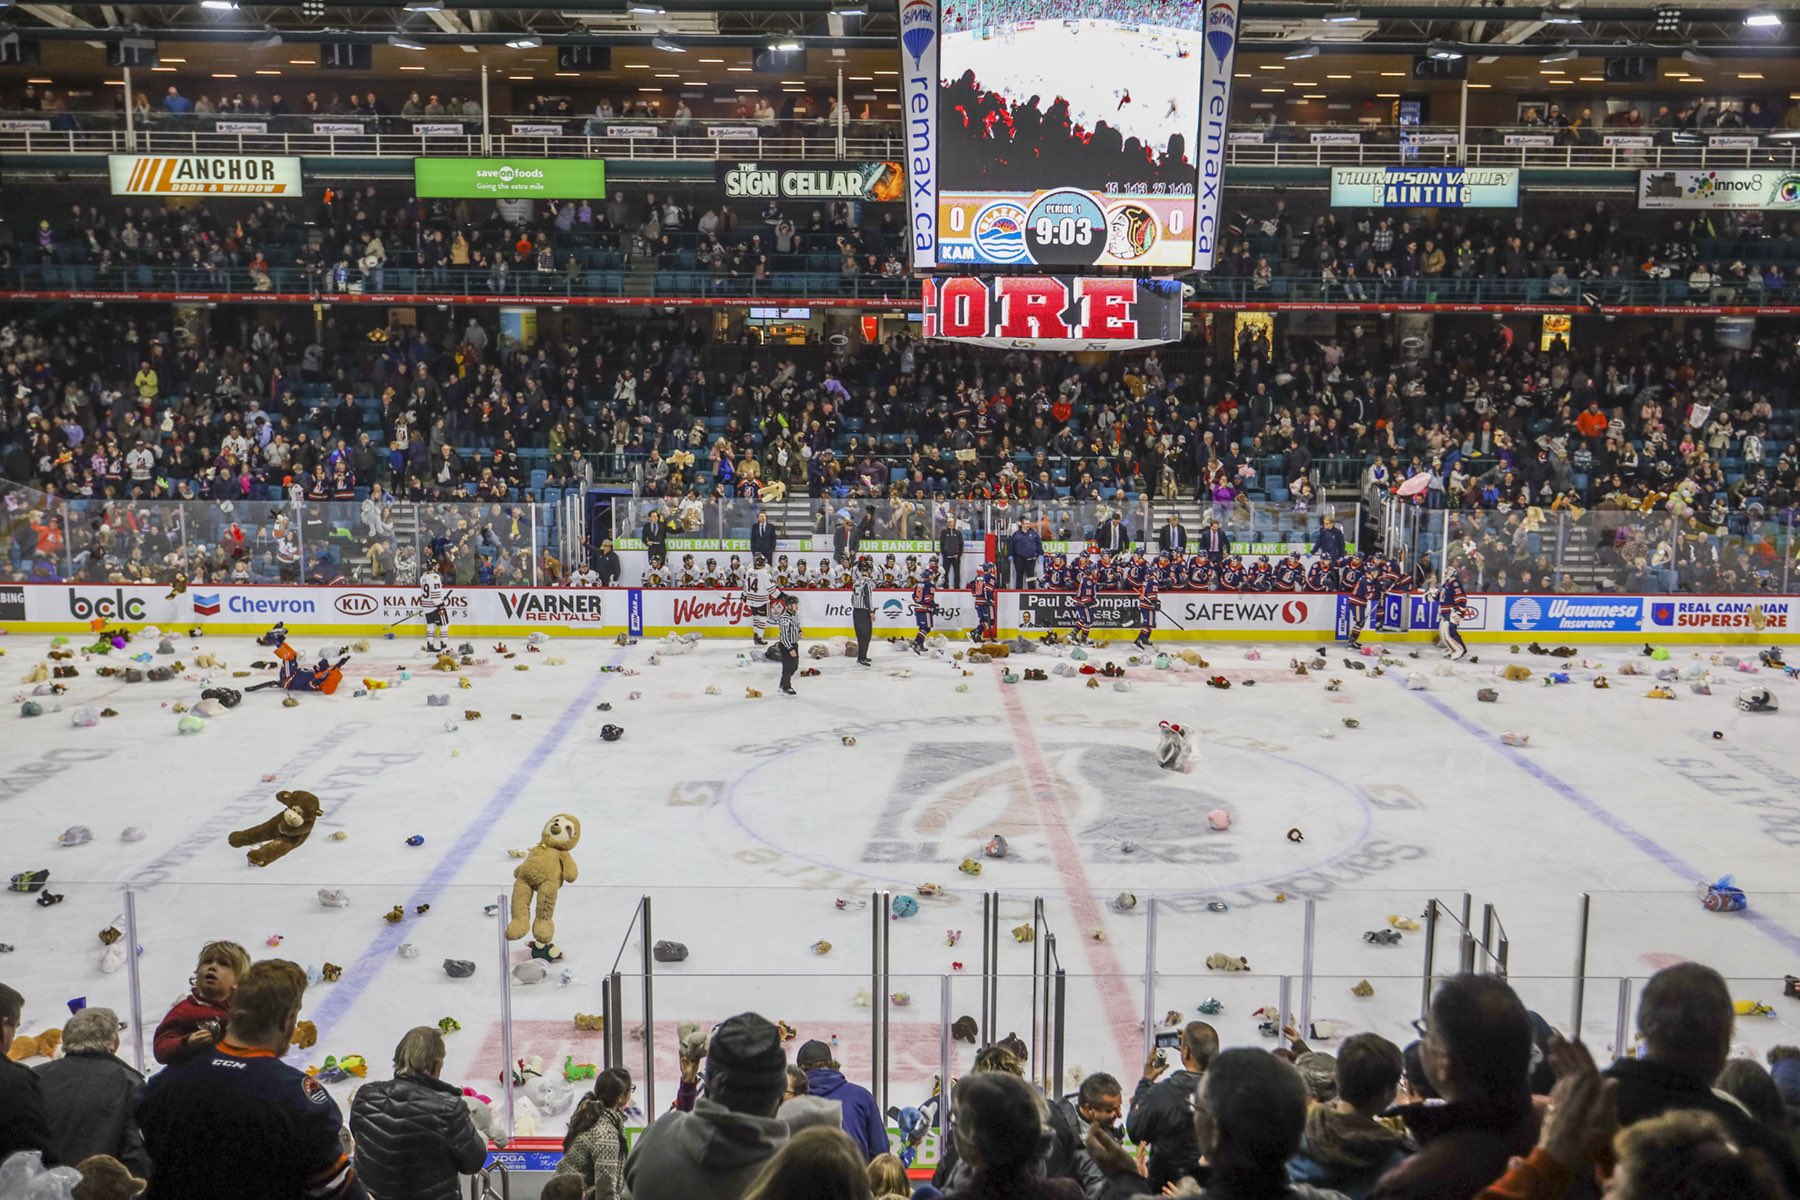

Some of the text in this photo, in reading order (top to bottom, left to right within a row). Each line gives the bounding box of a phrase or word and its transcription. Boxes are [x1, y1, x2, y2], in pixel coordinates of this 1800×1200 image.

[176, 158, 275, 180] ANCHOR
[738, 163, 757, 171] THE
[910, 76, 934, 252] remax.ca
[1197, 79, 1226, 254] remax.ca
[726, 170, 864, 197] SIGN CELLAR
[1337, 171, 1513, 186] THOMPSON VALLEY
[1714, 173, 1762, 191] innov8
[171, 183, 276, 193] DOOR & WINDOW
[476, 183, 497, 192] Going
[1373, 186, 1471, 203] PAINTING
[1045, 204, 1074, 214] PERIOD
[950, 207, 965, 232] 0
[1169, 210, 1184, 235] 0
[1036, 217, 1092, 245] 9:03
[942, 246, 975, 259] KAM
[695, 539, 729, 550] BANK
[882, 540, 914, 550] BANK
[747, 577, 758, 593] 14
[0, 592, 24, 603] BING
[69, 588, 147, 620] bclc
[228, 595, 315, 613] Chevron
[383, 596, 468, 608] KIA MRS
[1028, 596, 1060, 607] Paul
[1092, 598, 1140, 610] ompan
[343, 599, 371, 610] KIA
[498, 592, 601, 619] WARNER
[825, 604, 879, 616] Inter
[1548, 600, 1639, 617] Wawanesa
[1679, 603, 1711, 613] REAL
[526, 613, 601, 622] RENTALS
[1054, 610, 1121, 619] LAWERS
[1185, 603, 1279, 621] SAFEWAY
[1559, 618, 1615, 629] Insurance
[1678, 614, 1787, 627] SUPERSTRE
[212, 1058, 247, 1069] CCM
